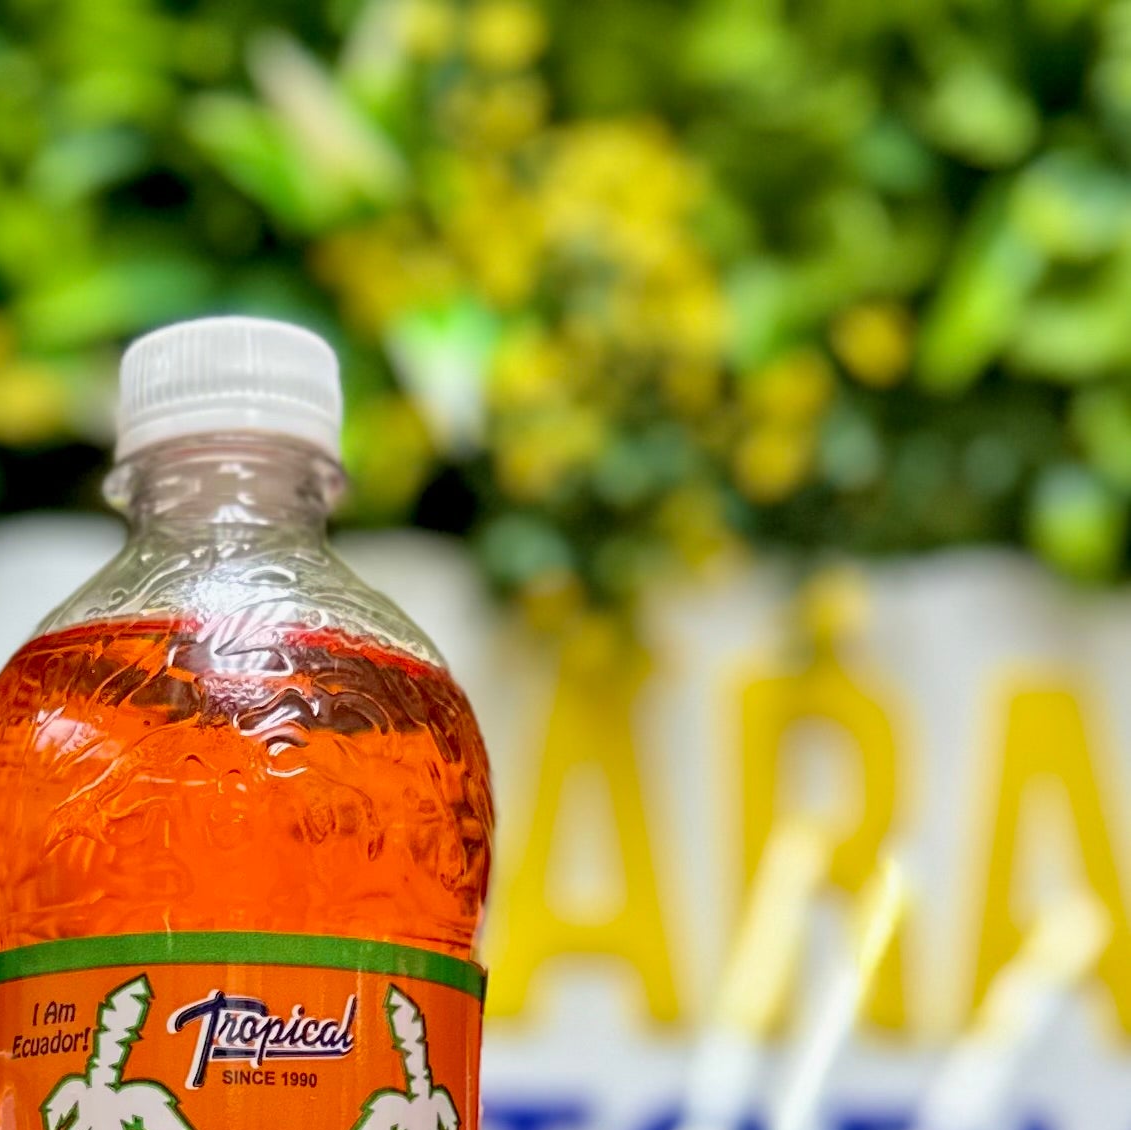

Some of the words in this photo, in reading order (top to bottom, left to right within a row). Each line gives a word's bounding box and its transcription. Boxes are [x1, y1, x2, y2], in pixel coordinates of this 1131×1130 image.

[31, 1003, 39, 1027] I
[44, 1002, 76, 1026] Am
[11, 1027, 90, 1059] Ecuador!
[167, 988, 357, 1090] Tropical
[221, 1069, 275, 1086] SINCE
[281, 1071, 317, 1088] 1990
